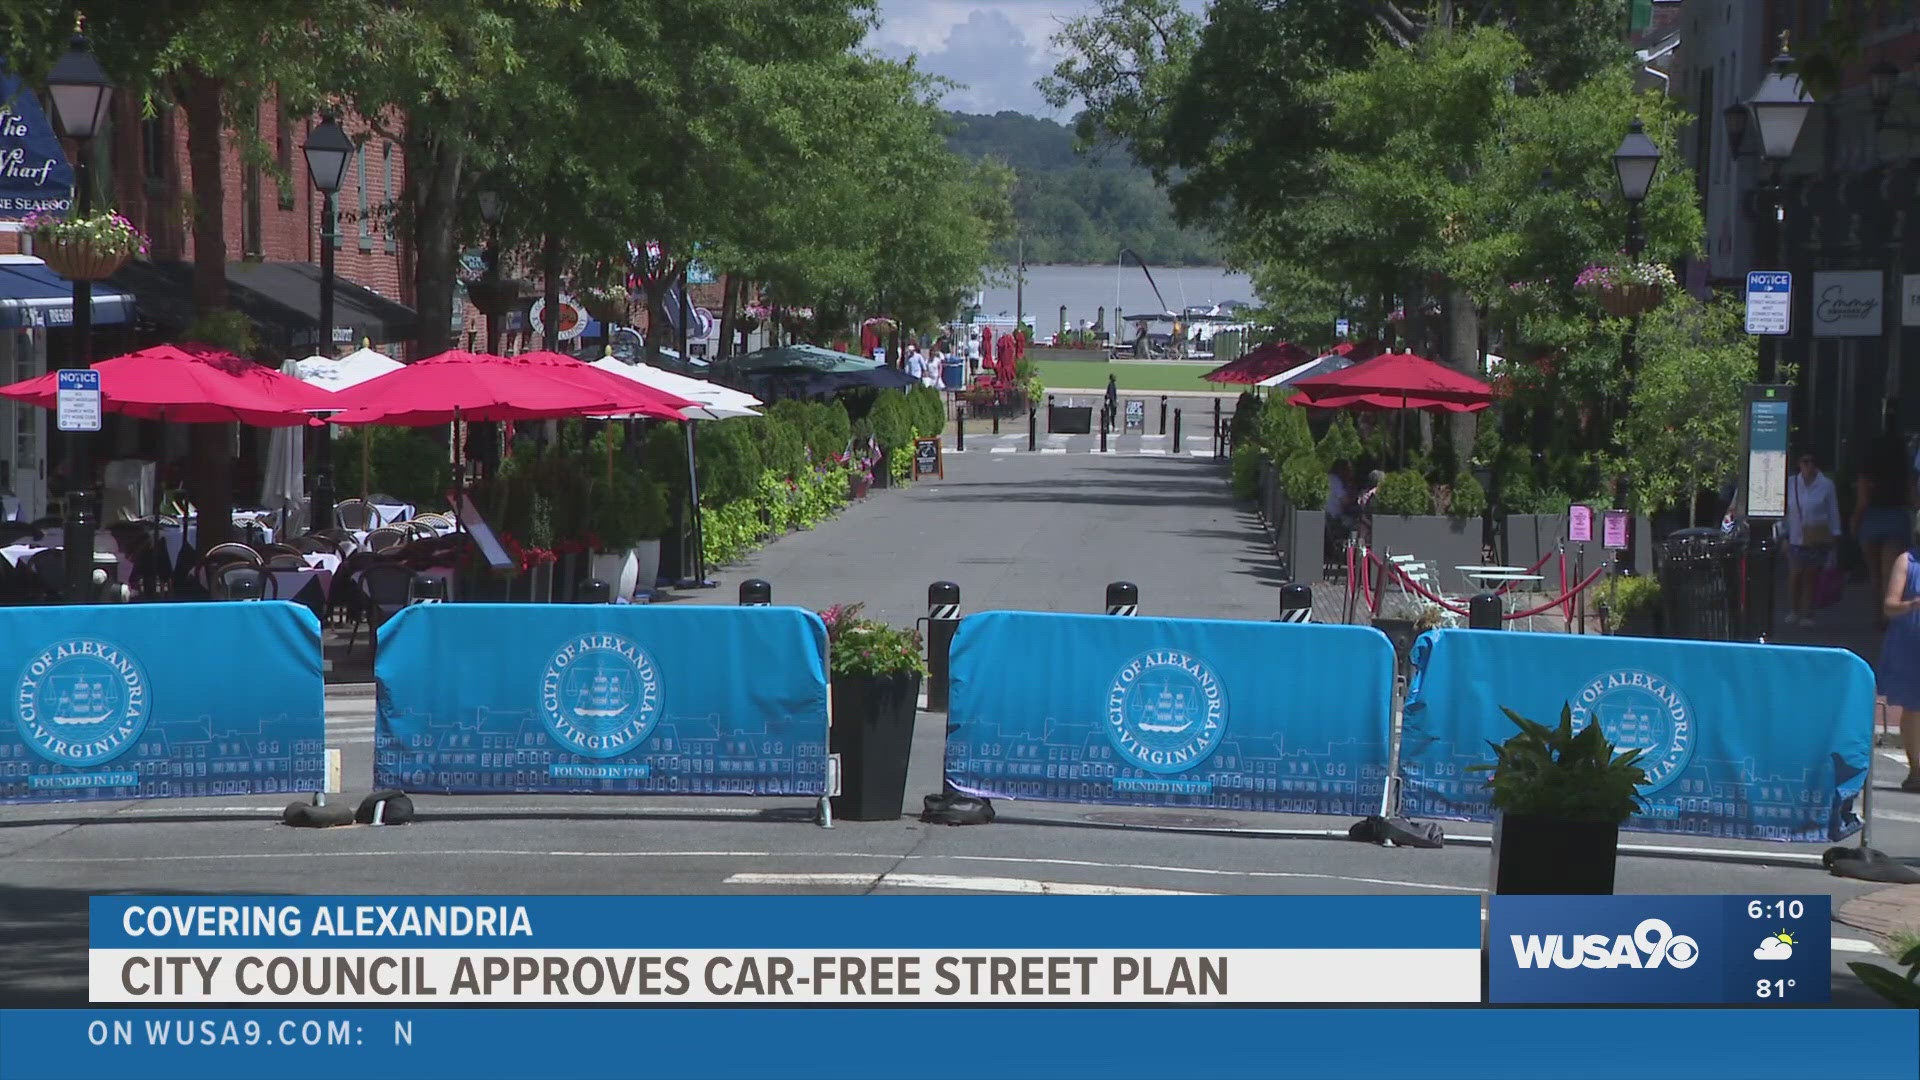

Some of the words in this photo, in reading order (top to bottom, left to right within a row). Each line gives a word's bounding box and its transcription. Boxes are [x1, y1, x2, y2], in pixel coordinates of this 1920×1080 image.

[1751, 275, 1788, 285] NOTICE
[60, 373, 97, 382] NOTICE
[20, 676, 37, 722] CITY
[31, 652, 53, 675] OF
[57, 641, 143, 718] ALEXANDRIA
[544, 666, 560, 712] CITY
[555, 644, 576, 667] OF
[579, 636, 657, 712] ALEXANDRIA
[1110, 681, 1126, 726] CITY
[1122, 660, 1142, 682] OF
[1145, 652, 1221, 730] ALEXANDRIA
[1571, 702, 1587, 739] ITY
[1583, 680, 1604, 702] OF
[1608, 672, 1688, 752] ALEXANDRIA
[33, 726, 133, 758] VIRGINIA
[554, 714, 646, 749] VIRGINIA
[1119, 731, 1209, 765] VIRGINIA
[34, 776, 92, 788] FOUNDED
[94, 775, 106, 786] IN
[109, 774, 133, 785] 1749
[554, 766, 607, 777] FOUNDED
[609, 767, 620, 777] IN
[1117, 780, 1170, 792] FOUNDED
[1172, 782, 1184, 792] IN
